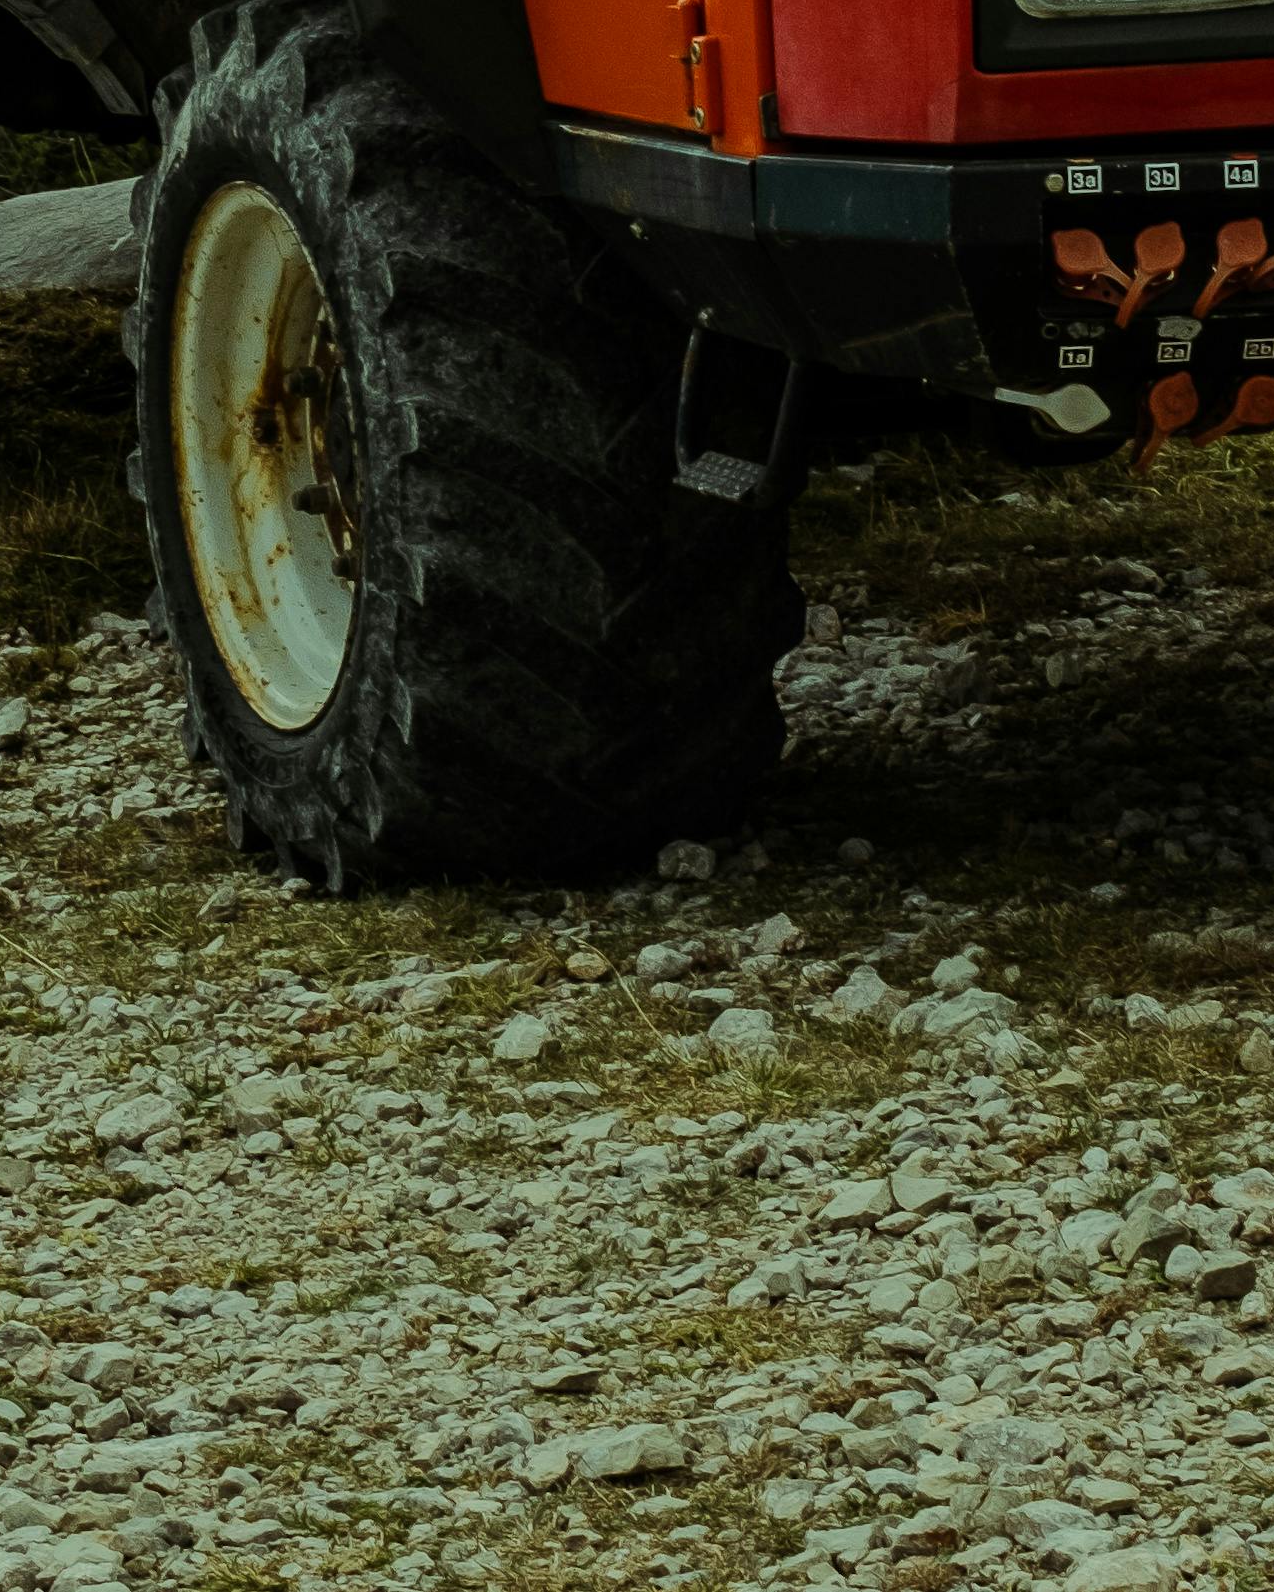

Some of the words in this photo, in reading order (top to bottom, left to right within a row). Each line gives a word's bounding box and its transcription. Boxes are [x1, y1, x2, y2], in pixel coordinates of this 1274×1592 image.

[1073, 172, 1096, 188] 3a
[1150, 169, 1174, 186] 3b
[1230, 166, 1253, 183] 4a
[1164, 346, 1185, 359] 2a
[1249, 341, 1272, 356] 2b
[1067, 351, 1087, 364] 1a
